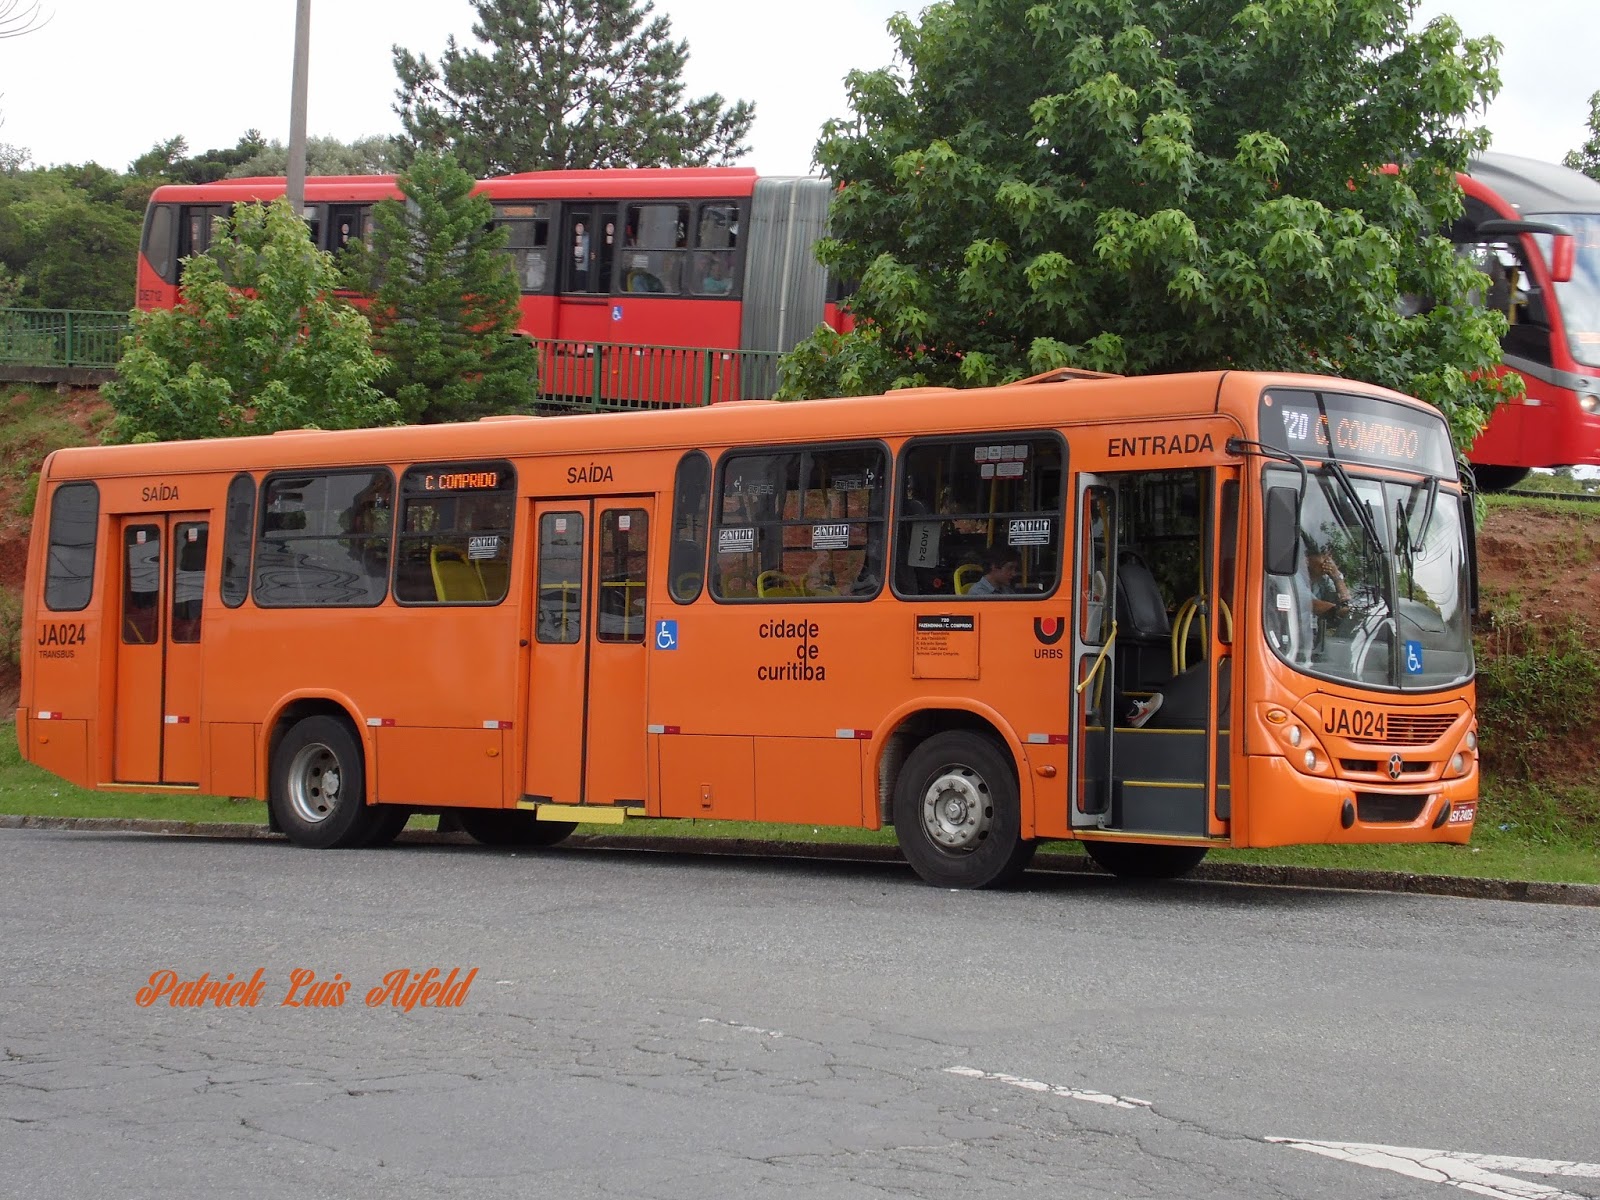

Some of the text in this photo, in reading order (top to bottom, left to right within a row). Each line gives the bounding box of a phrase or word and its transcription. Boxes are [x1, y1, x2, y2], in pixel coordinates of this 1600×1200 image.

[1107, 433, 1214, 457] ENTRADA
[1338, 418, 1418, 459] COMPRIDO
[438, 472, 497, 489] COMPRIDO
[567, 462, 614, 484] SAÍDA
[141, 482, 179, 502] SAÍDA
[918, 525, 929, 562] JA024
[37, 623, 86, 646] JA024
[759, 618, 819, 638] cidade
[38, 649, 75, 659] TRANSBUS
[796, 641, 819, 660] de
[1034, 648, 1064, 659] URBS
[757, 661, 826, 681] curitiba
[1324, 707, 1385, 738] JA024
